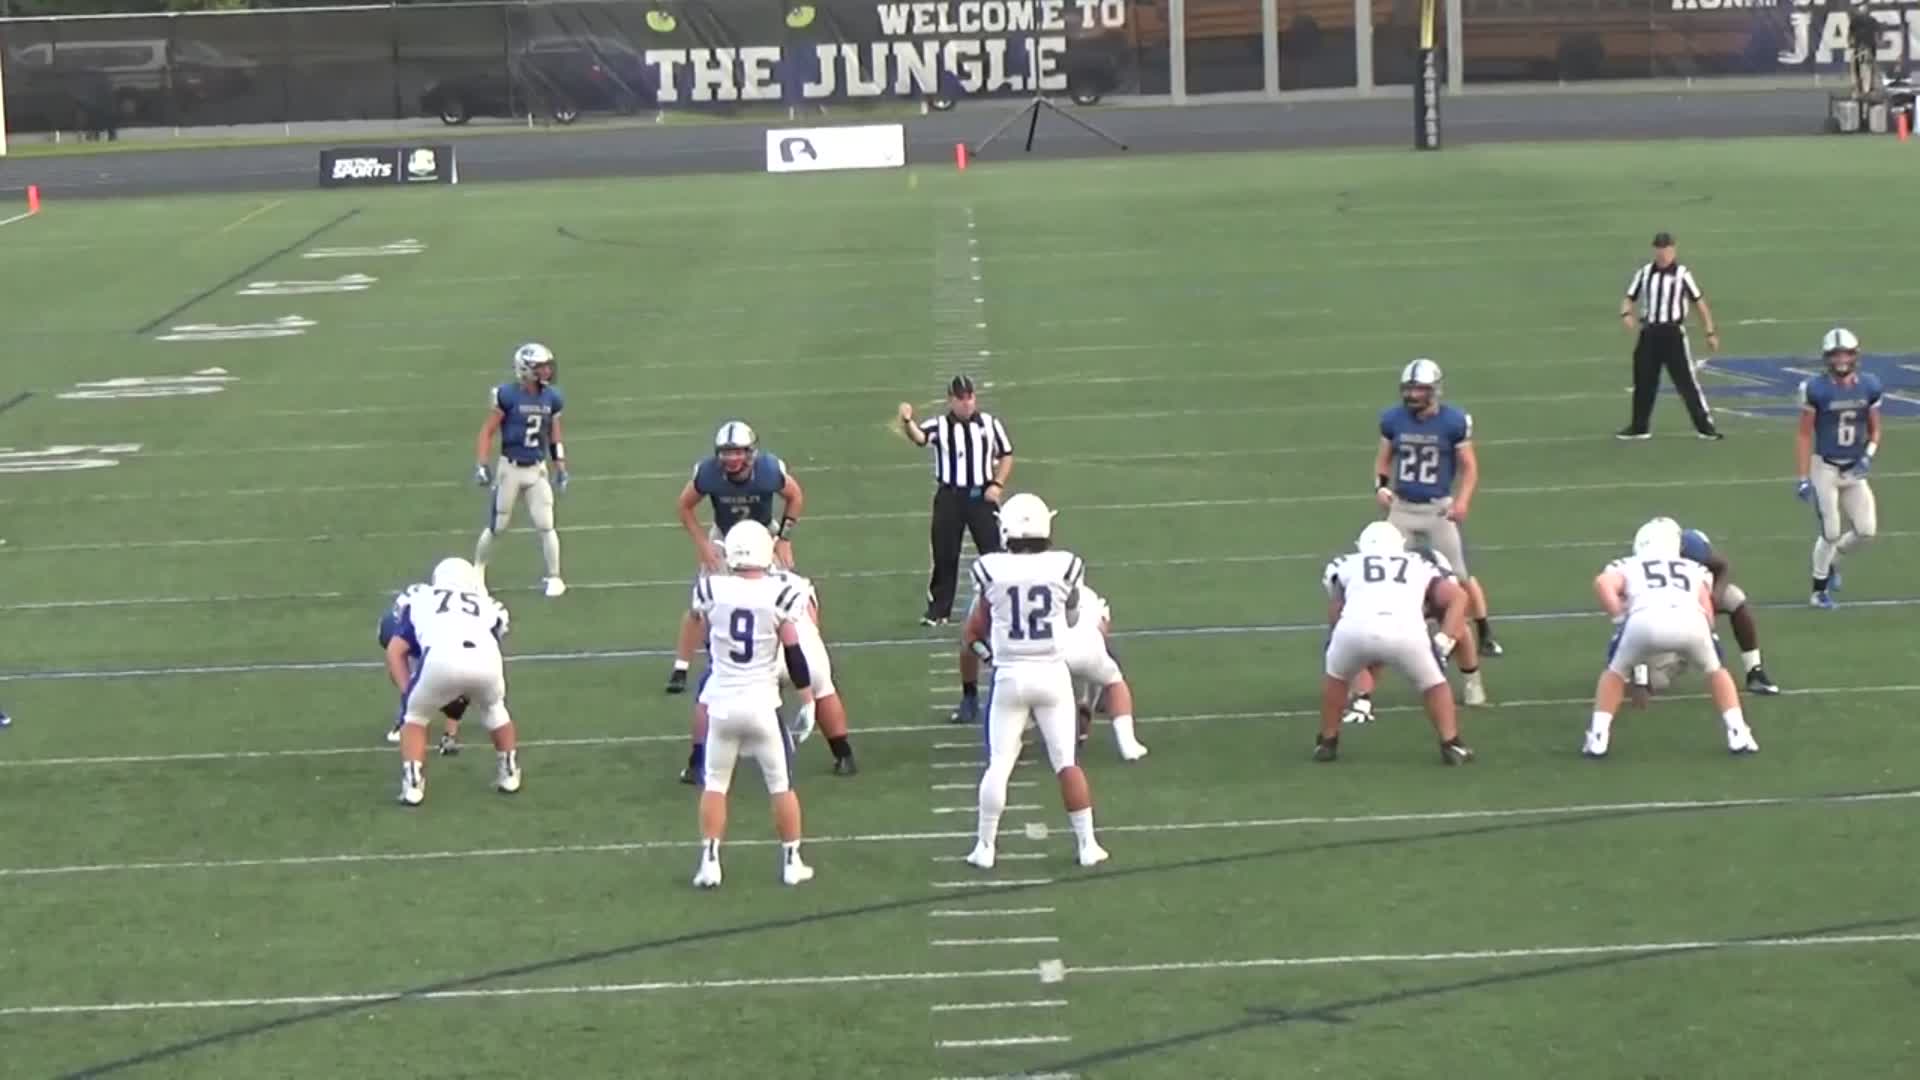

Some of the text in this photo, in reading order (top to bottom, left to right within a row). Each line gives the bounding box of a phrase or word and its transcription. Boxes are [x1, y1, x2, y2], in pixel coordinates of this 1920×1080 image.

[878, 0, 1125, 34] WELCOME TO
[644, 36, 1067, 102] THE JUNGLE
[332, 163, 391, 178] SPORTS
[524, 414, 542, 447] 2
[1838, 410, 1856, 447] 6
[1399, 444, 1439, 484] 22
[1363, 556, 1410, 584] 67
[1641, 560, 1692, 592] 55
[433, 588, 480, 617] 75
[1007, 584, 1053, 640] 12
[729, 608, 754, 663] 9
